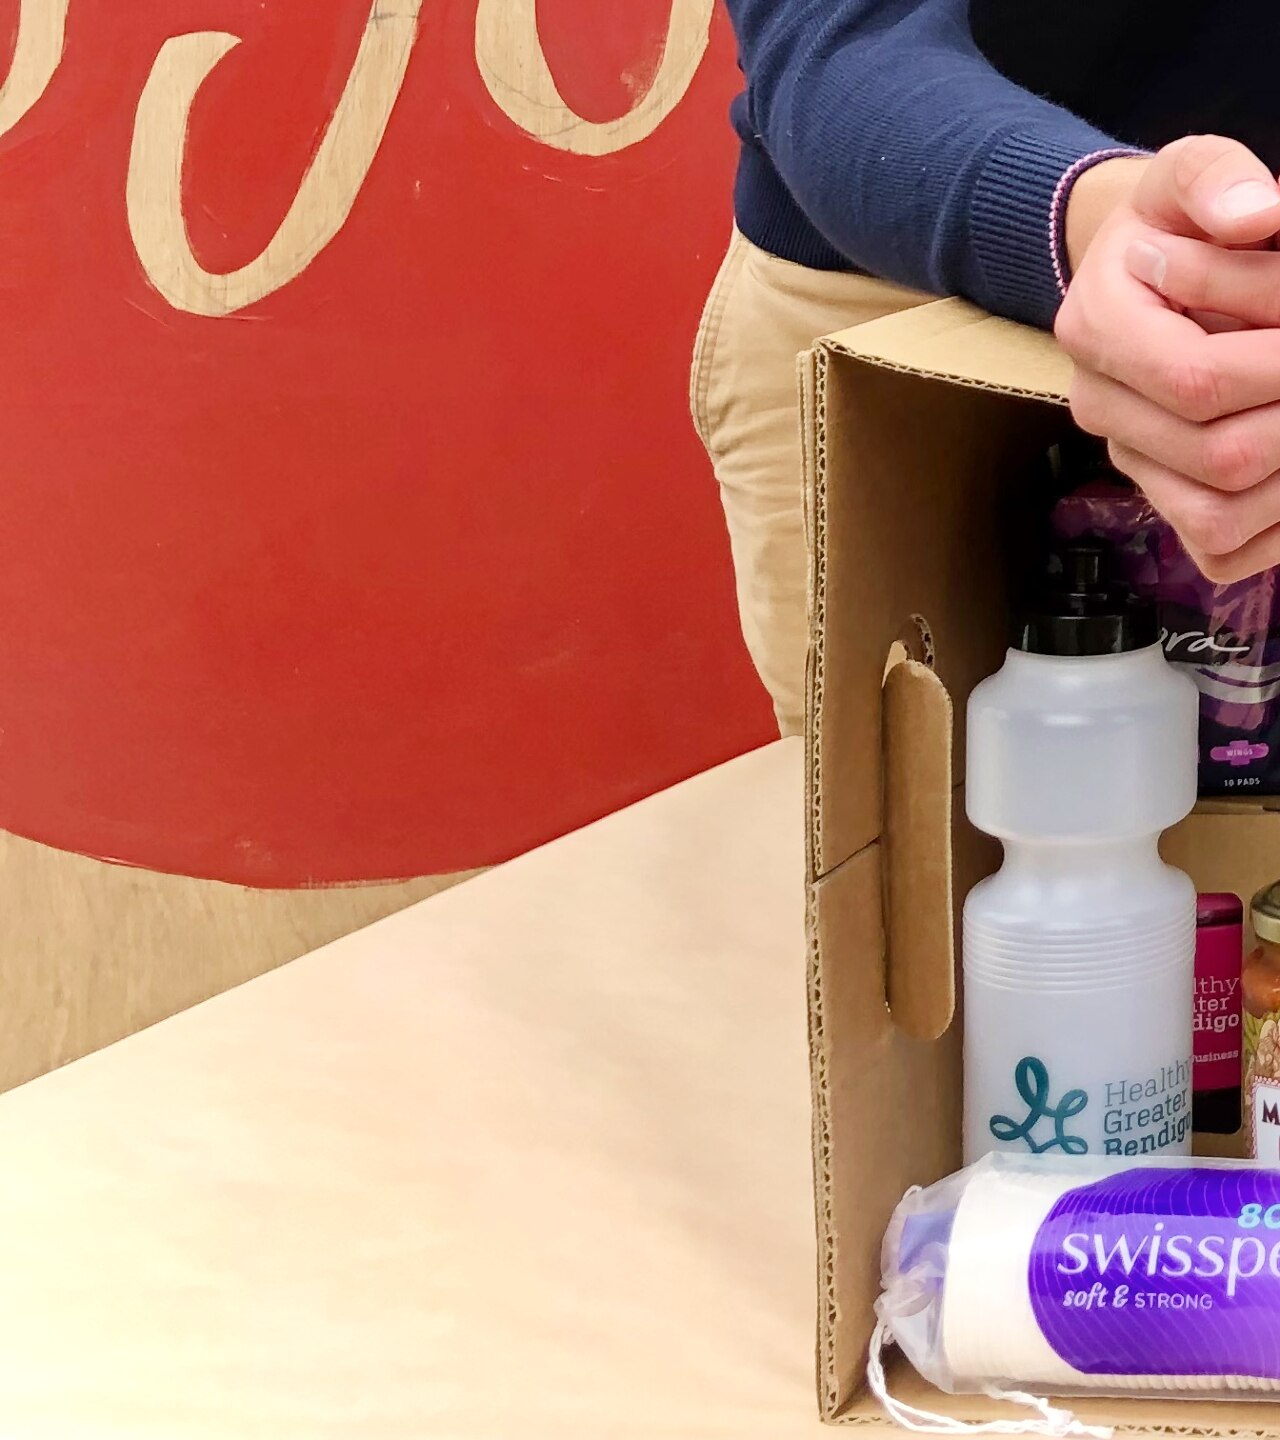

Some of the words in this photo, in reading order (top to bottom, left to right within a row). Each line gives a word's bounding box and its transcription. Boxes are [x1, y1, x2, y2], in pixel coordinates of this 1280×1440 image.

[1236, 776, 1261, 787] PADS
[1192, 994, 1229, 1012] ter
[1104, 1056, 1192, 1108] Healthy
[1103, 1087, 1188, 1135] Greater
[1103, 1110, 1192, 1157] Bendigo
[1061, 1281, 1108, 1311] soft
[1111, 1283, 1129, 1309] &
[1133, 1291, 1213, 1310] STRONG
